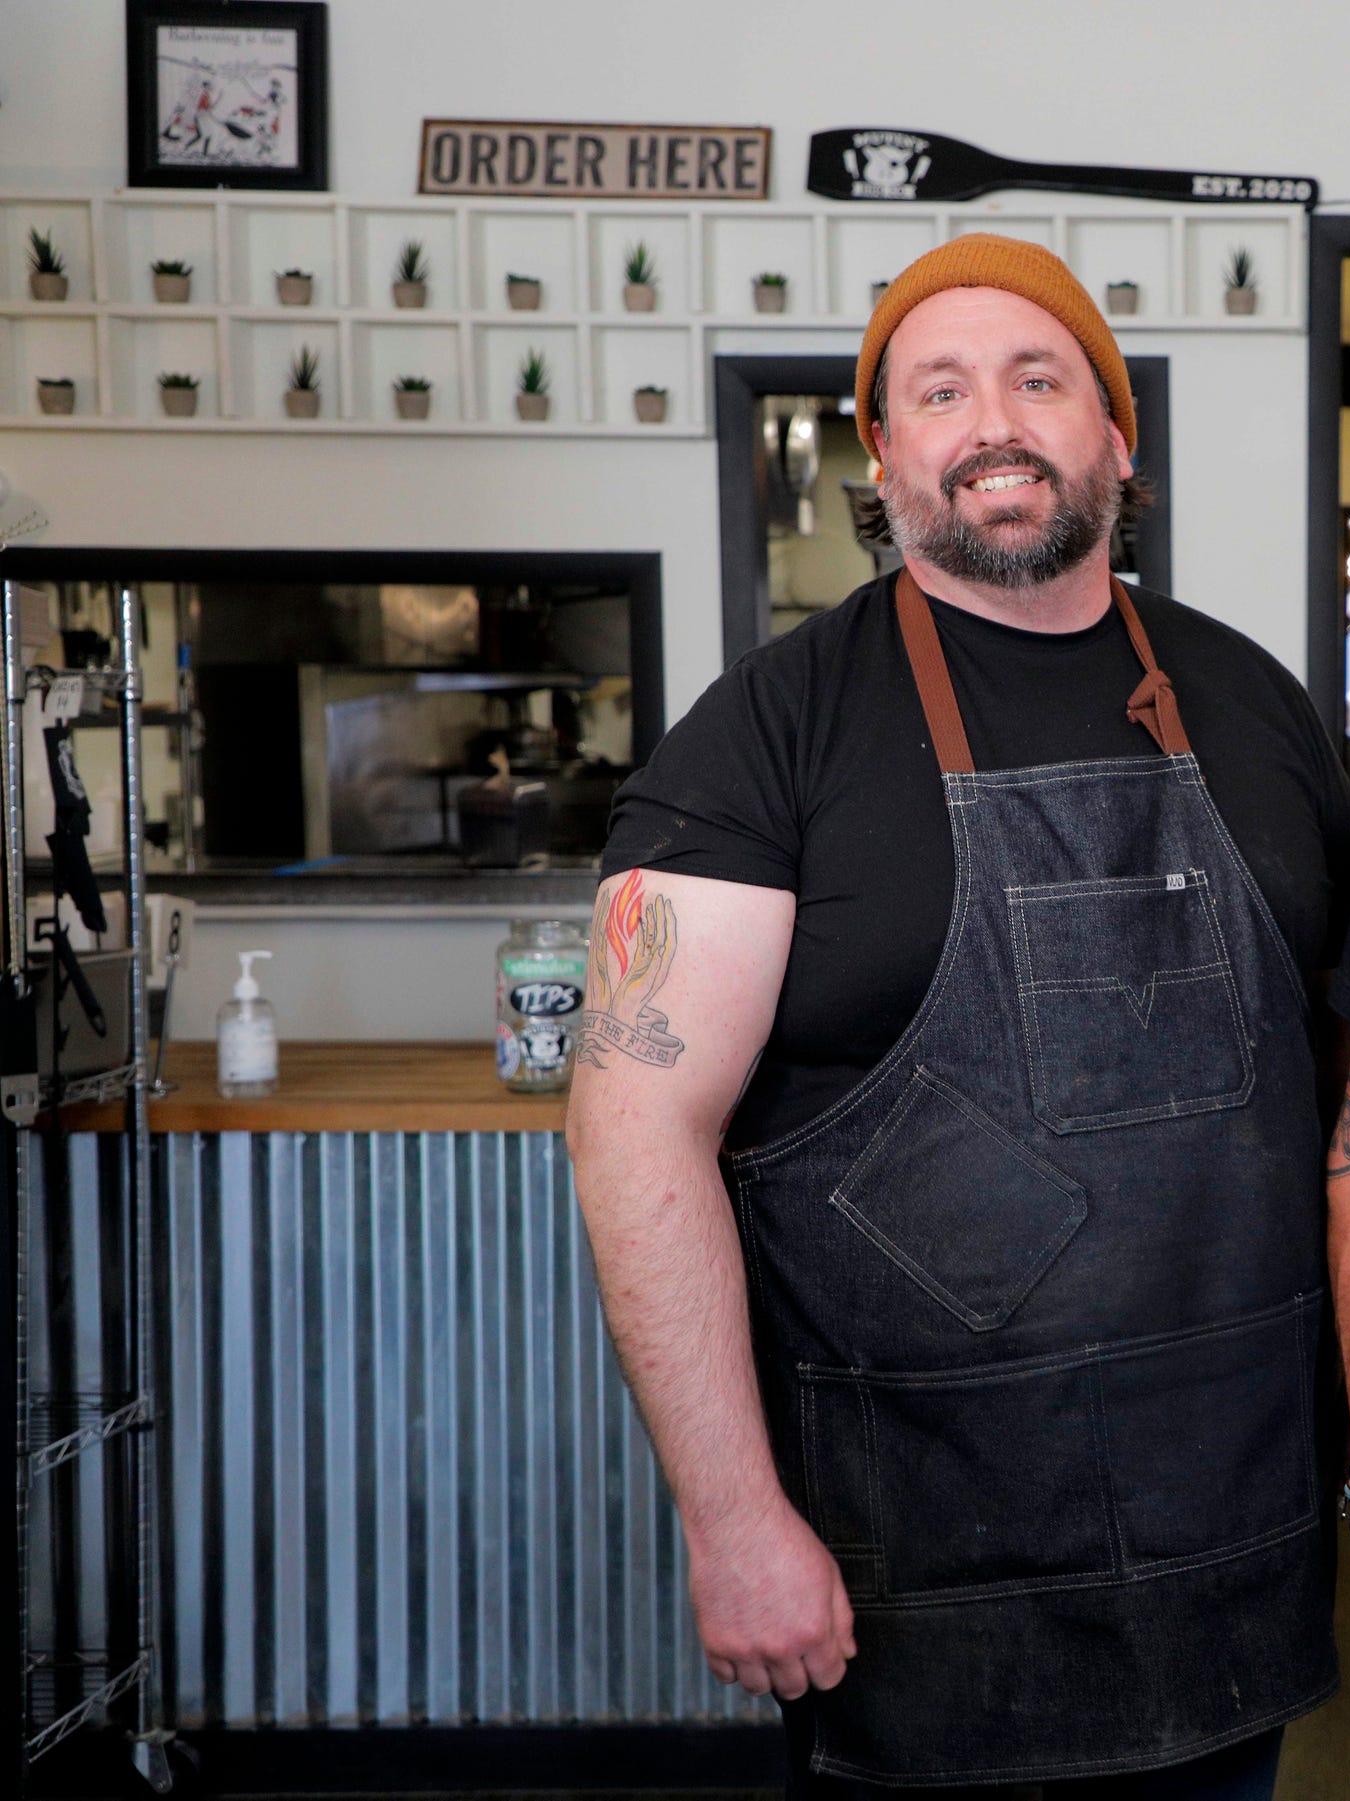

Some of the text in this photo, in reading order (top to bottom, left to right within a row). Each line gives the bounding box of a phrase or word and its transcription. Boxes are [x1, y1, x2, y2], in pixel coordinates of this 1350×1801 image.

[431, 132, 760, 190] ORDER HERE
[1192, 175, 1312, 201] EST. 2020
[170, 910, 181, 954] 8
[515, 983, 576, 1013] TIPS
[600, 1018, 625, 1042] THE
[625, 1033, 669, 1063] FIRE
